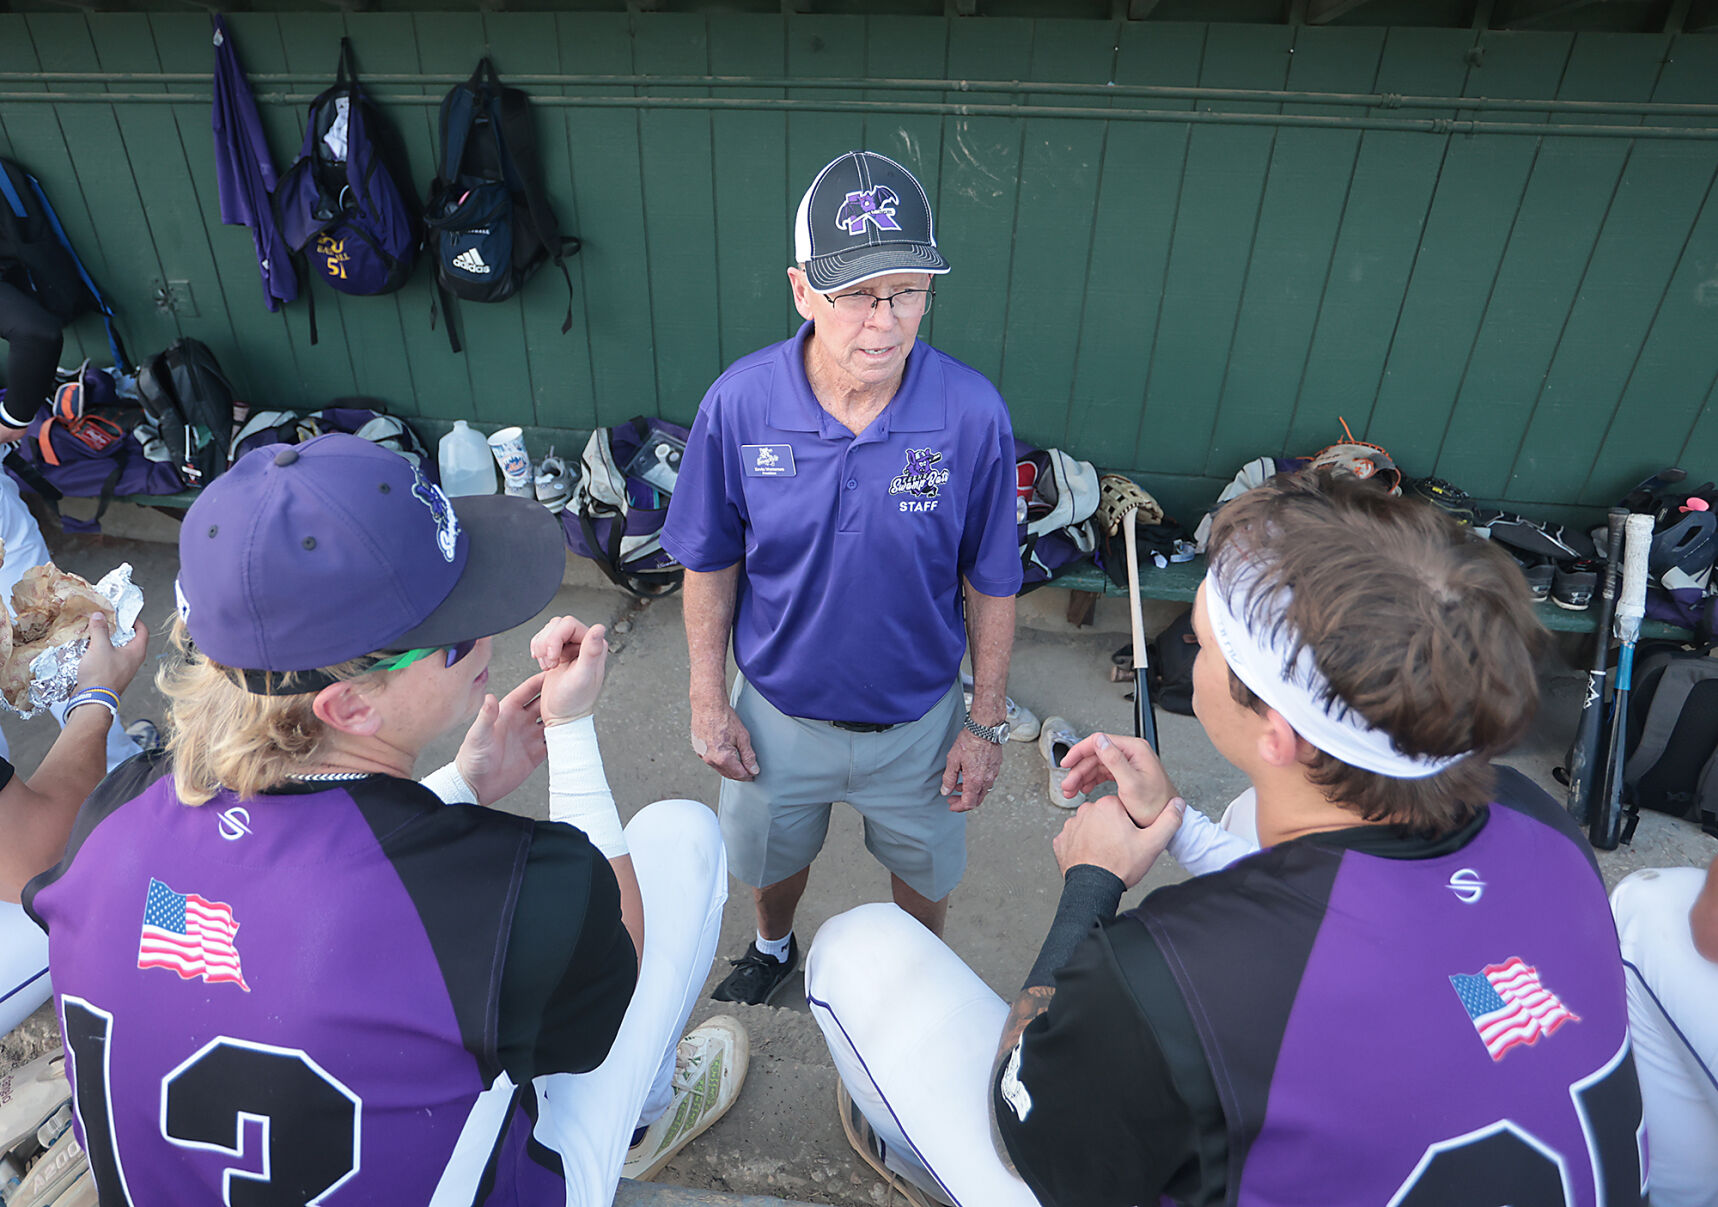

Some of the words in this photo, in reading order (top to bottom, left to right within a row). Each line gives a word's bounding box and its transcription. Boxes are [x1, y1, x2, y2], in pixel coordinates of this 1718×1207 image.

[452, 258, 491, 274] adidas
[891, 477, 927, 494] Swamp
[899, 500, 939, 512] STAFF
